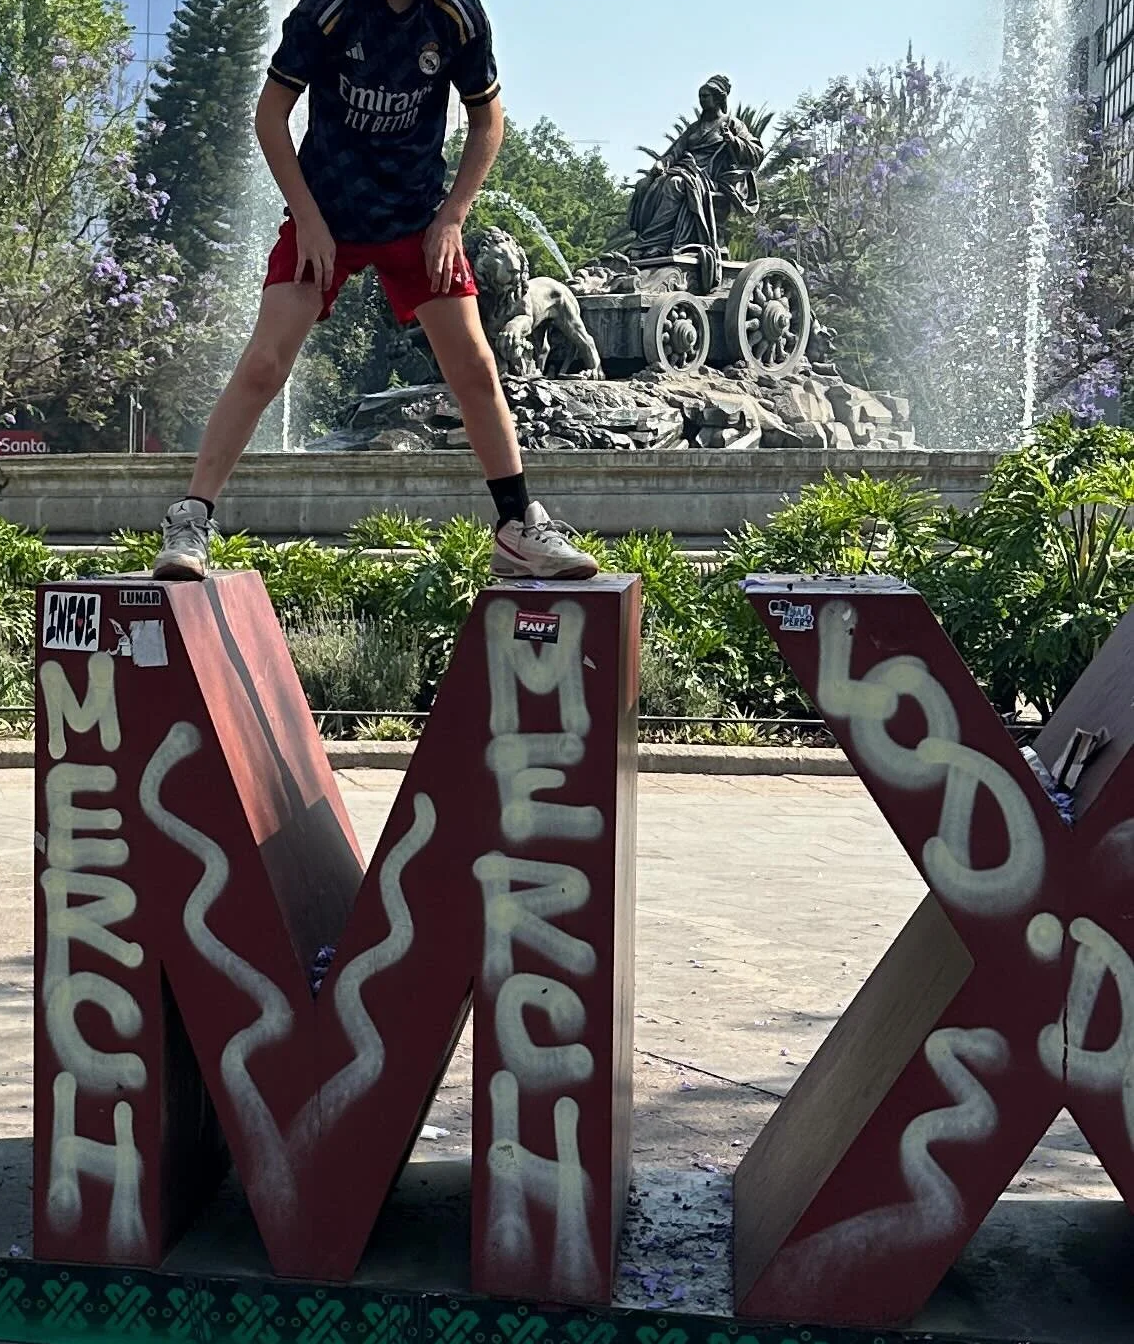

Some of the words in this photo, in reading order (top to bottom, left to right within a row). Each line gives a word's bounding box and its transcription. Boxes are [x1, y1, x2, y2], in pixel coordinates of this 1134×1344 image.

[345, 108, 370, 132] FLY
[2, 438, 50, 453] Santa
[120, 591, 160, 604] LUNAR
[518, 621, 545, 632] FAU
[39, 652, 148, 1258] MERCH
[472, 598, 604, 1298] MERCH
